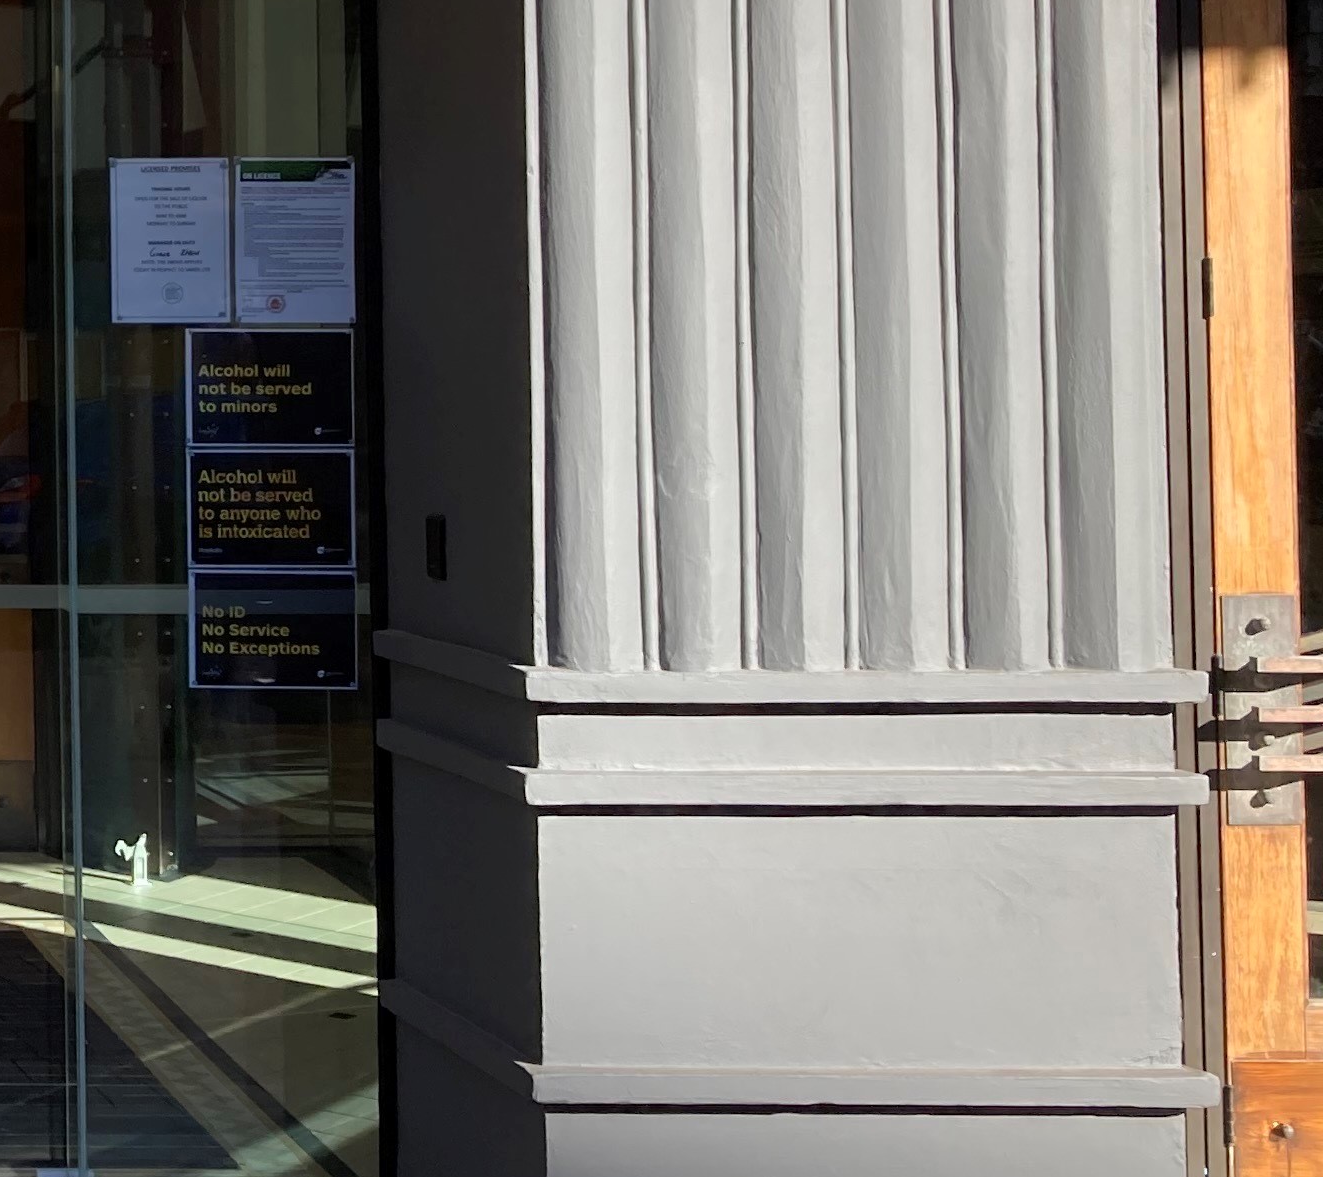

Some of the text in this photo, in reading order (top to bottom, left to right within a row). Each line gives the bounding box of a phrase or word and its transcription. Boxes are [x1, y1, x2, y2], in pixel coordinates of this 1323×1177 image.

[198, 364, 291, 377] Alcohol will
[198, 382, 313, 395] not be served
[198, 399, 278, 413] to minors
[198, 469, 297, 484] Alcohol will
[197, 487, 314, 503] not be served
[198, 506, 322, 523] to anyone who
[198, 524, 311, 539] is intoxicated
[202, 606, 246, 619] No ID
[202, 624, 290, 637] No Service
[202, 642, 321, 657] No Exceptions
